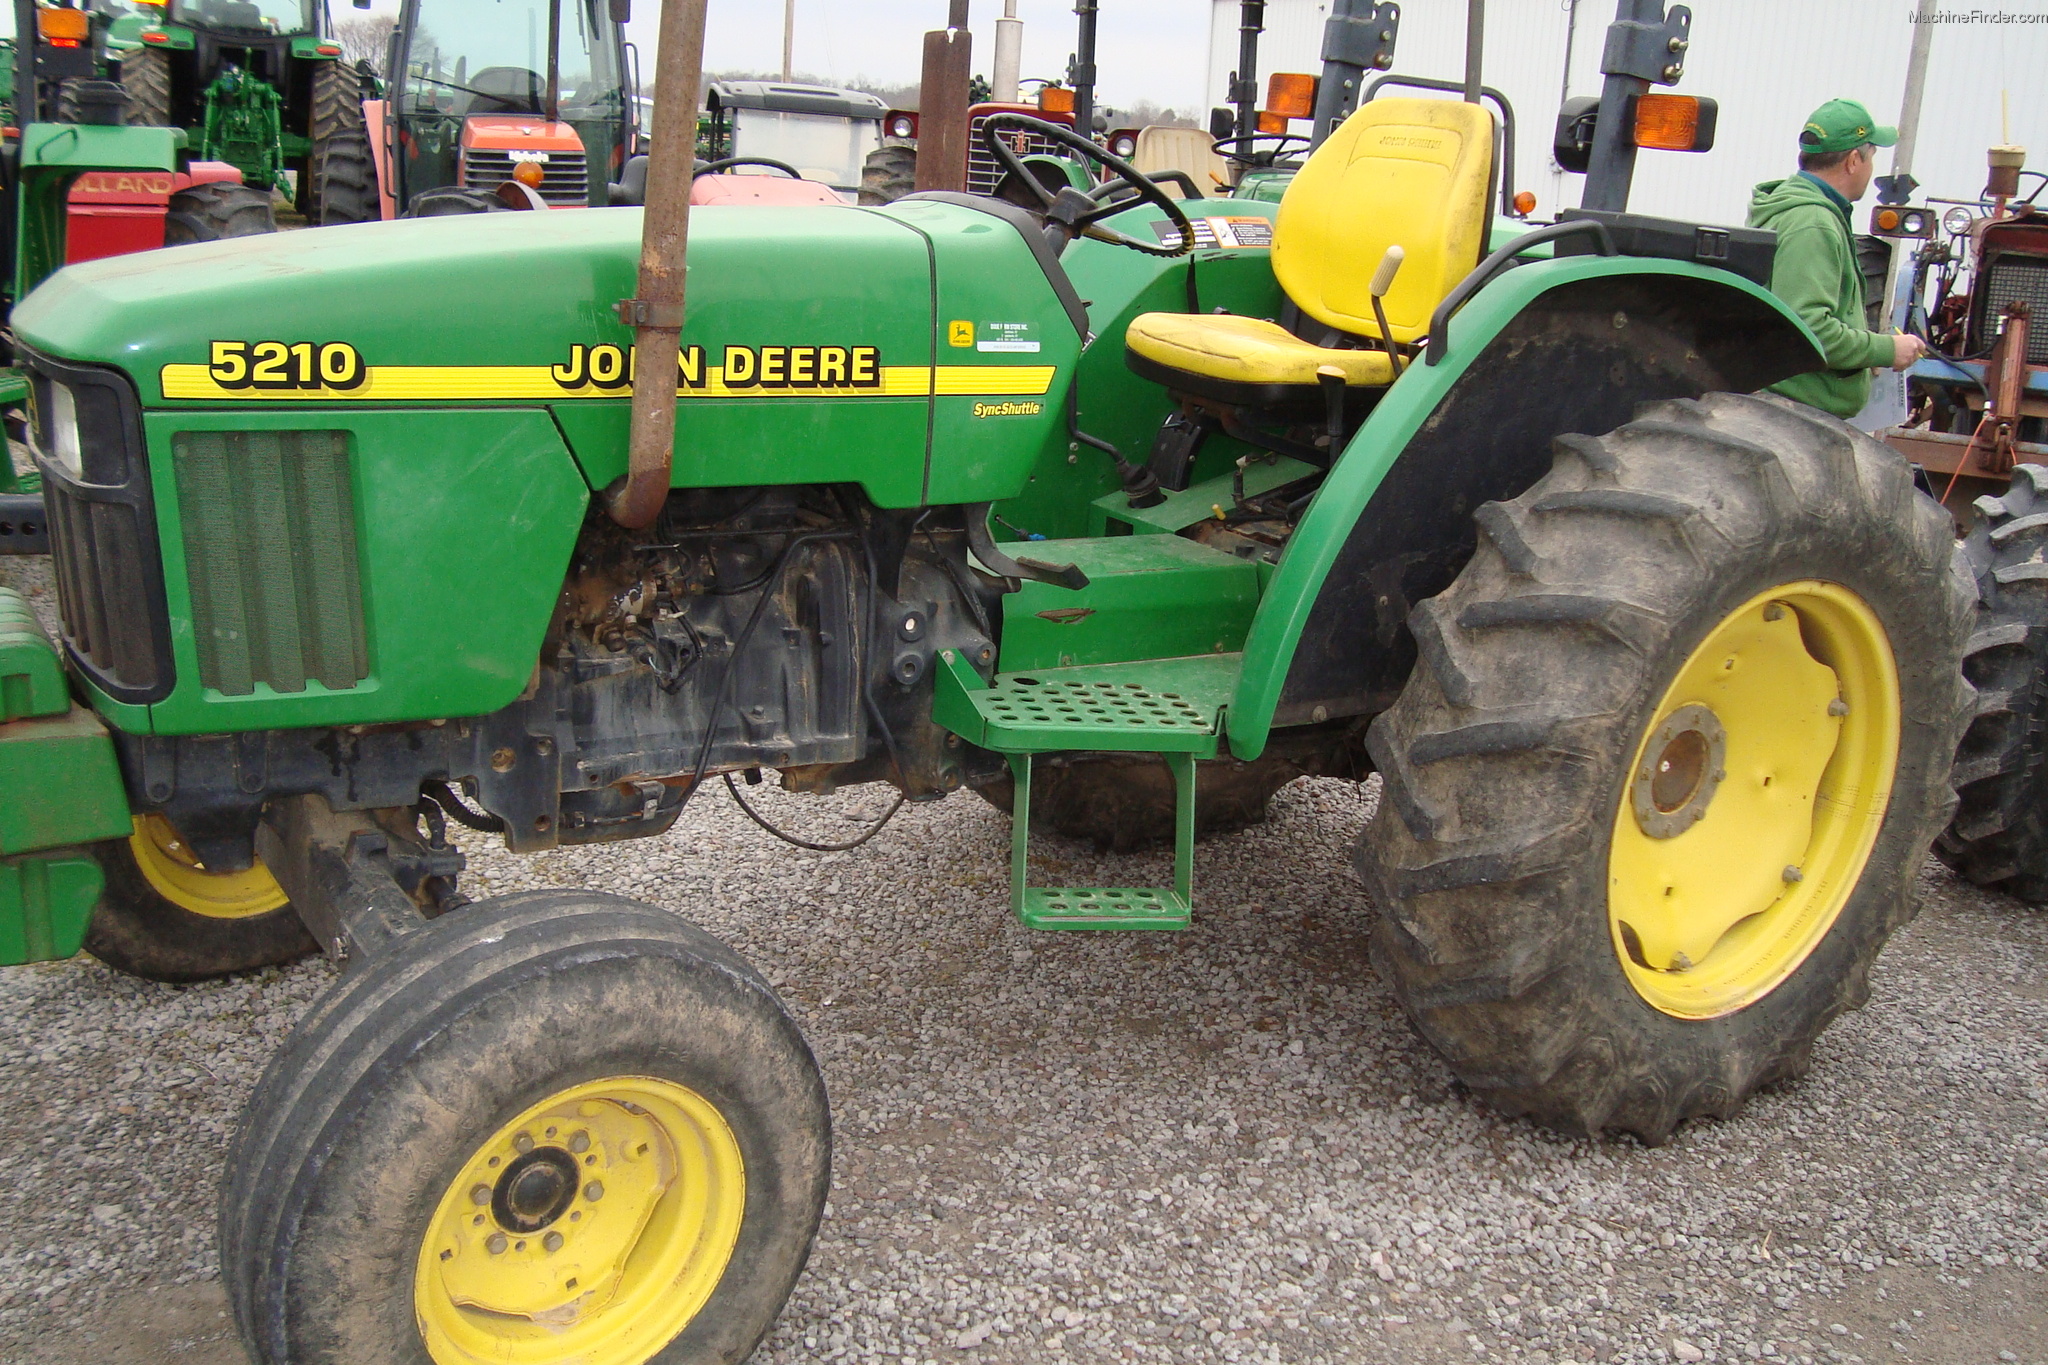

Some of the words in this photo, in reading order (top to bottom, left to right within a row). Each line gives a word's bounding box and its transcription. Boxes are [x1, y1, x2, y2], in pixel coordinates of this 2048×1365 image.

[209, 340, 365, 390] 5210
[551, 343, 706, 389] JON
[723, 345, 880, 388] DEERE
[973, 401, 1040, 419] SyncShuttle
